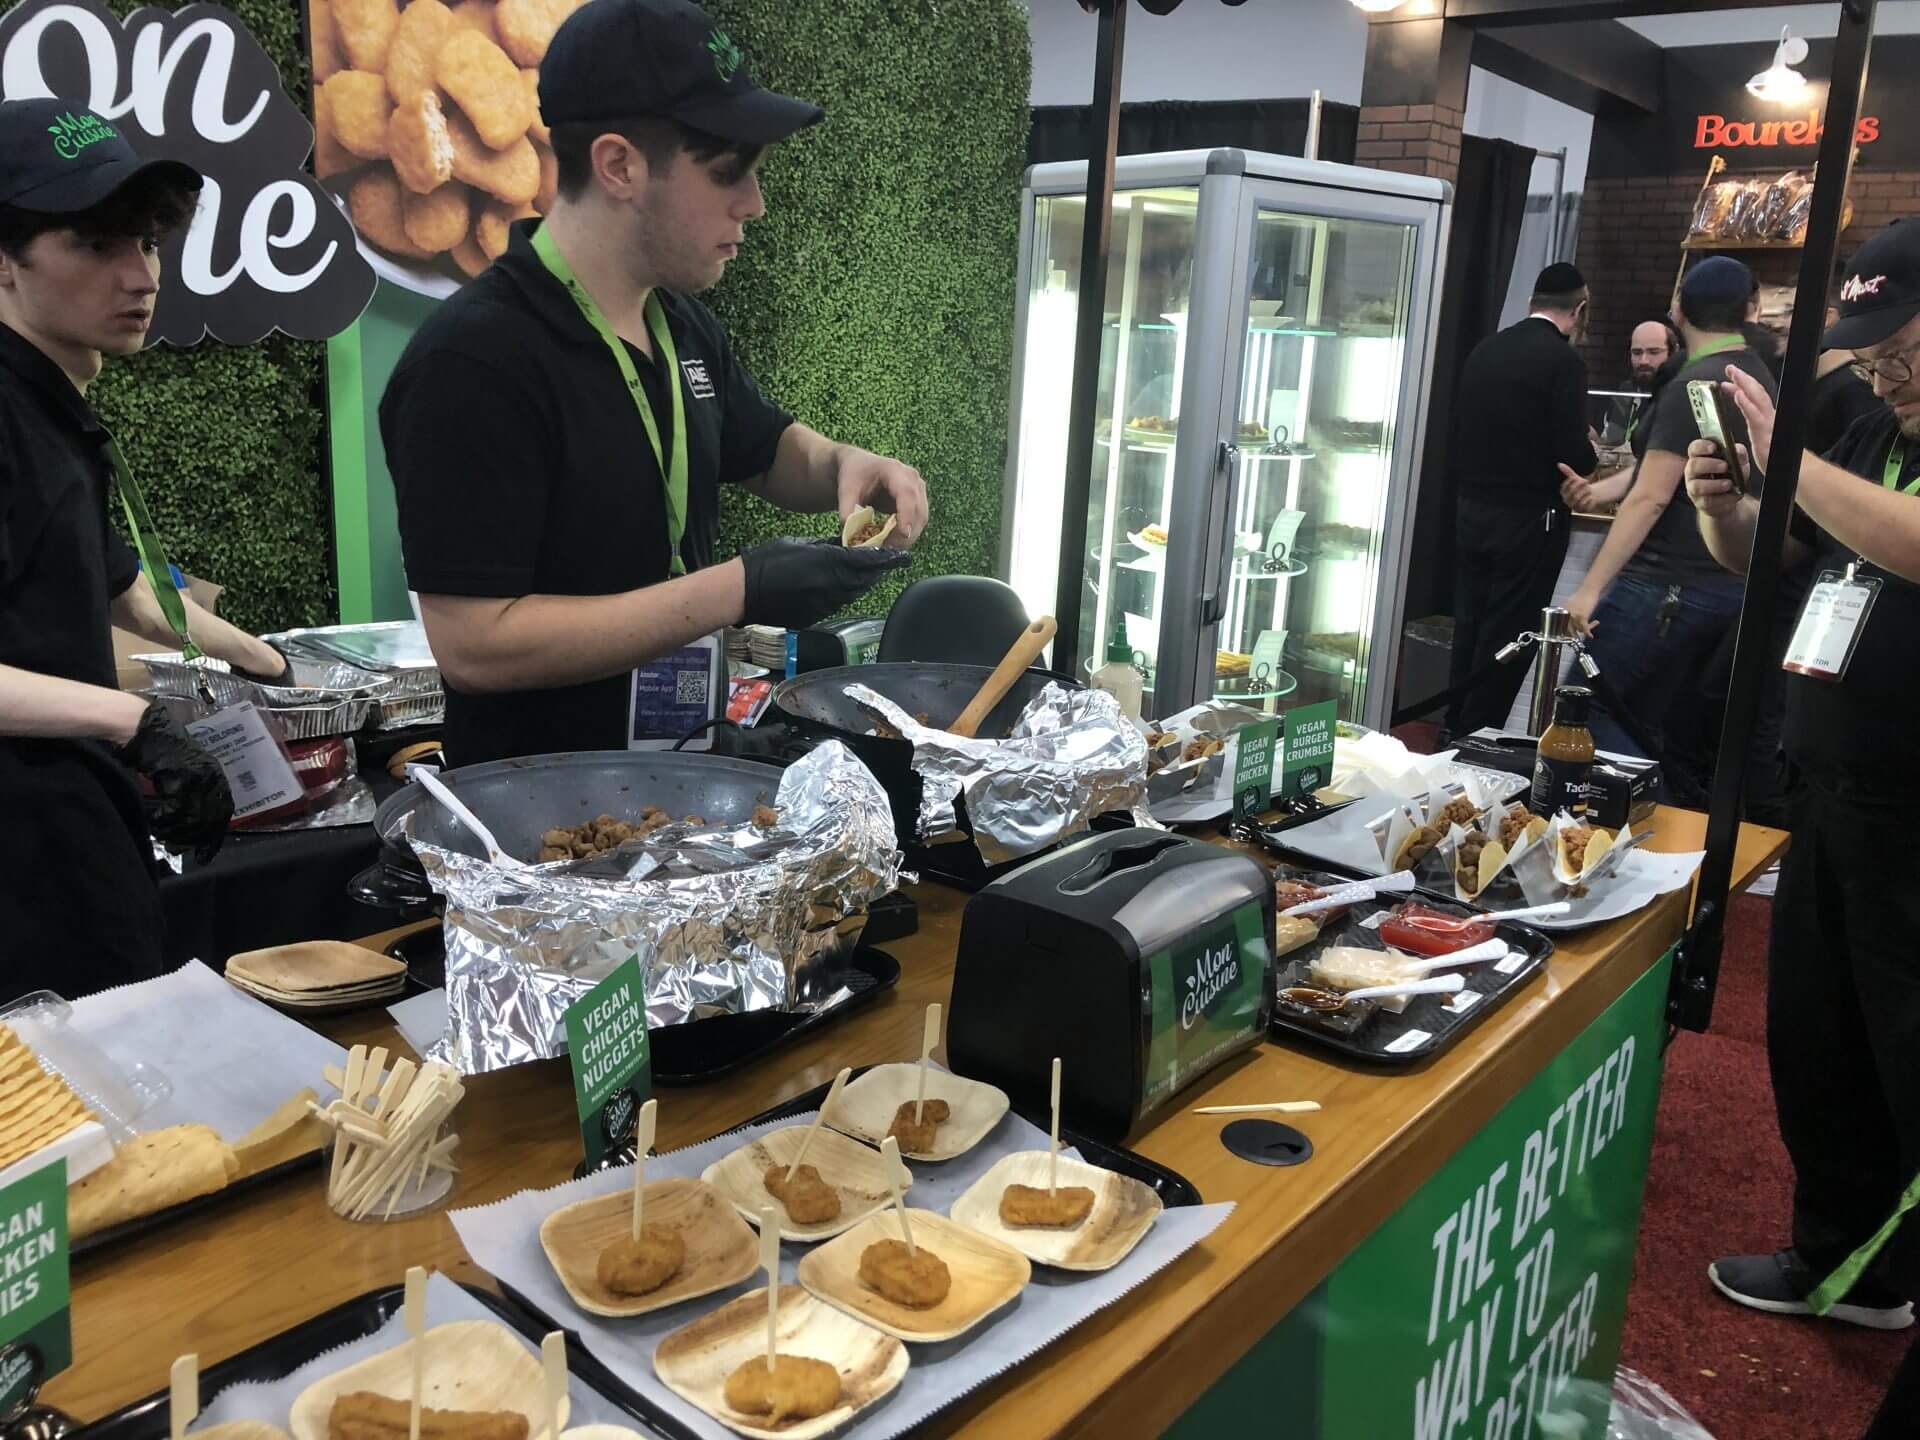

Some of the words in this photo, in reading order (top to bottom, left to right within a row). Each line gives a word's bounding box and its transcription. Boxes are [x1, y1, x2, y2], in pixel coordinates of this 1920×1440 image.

[55, 111, 102, 137] Mon
[1694, 107, 1880, 148] Boureks
[1243, 736, 1269, 754] VEGAN
[1292, 731, 1329, 749] BURGER
[1296, 719, 1326, 735] VEGAN
[1242, 751, 1265, 768] DICED
[1286, 742, 1334, 762] CRUMBLES
[1236, 763, 1269, 784] CHICKEN
[1194, 942, 1233, 995] Mon
[583, 983, 630, 1035] VEGAN
[1181, 960, 1239, 1031] Cuisine
[582, 1001, 639, 1065] CHICKEN
[583, 1023, 646, 1093] NUGGETS
[1427, 1160, 1508, 1346] THE
[1510, 1034, 1636, 1250] BETTER
[1413, 1284, 1504, 1440] WAY
[1508, 1228, 1555, 1363] TO
